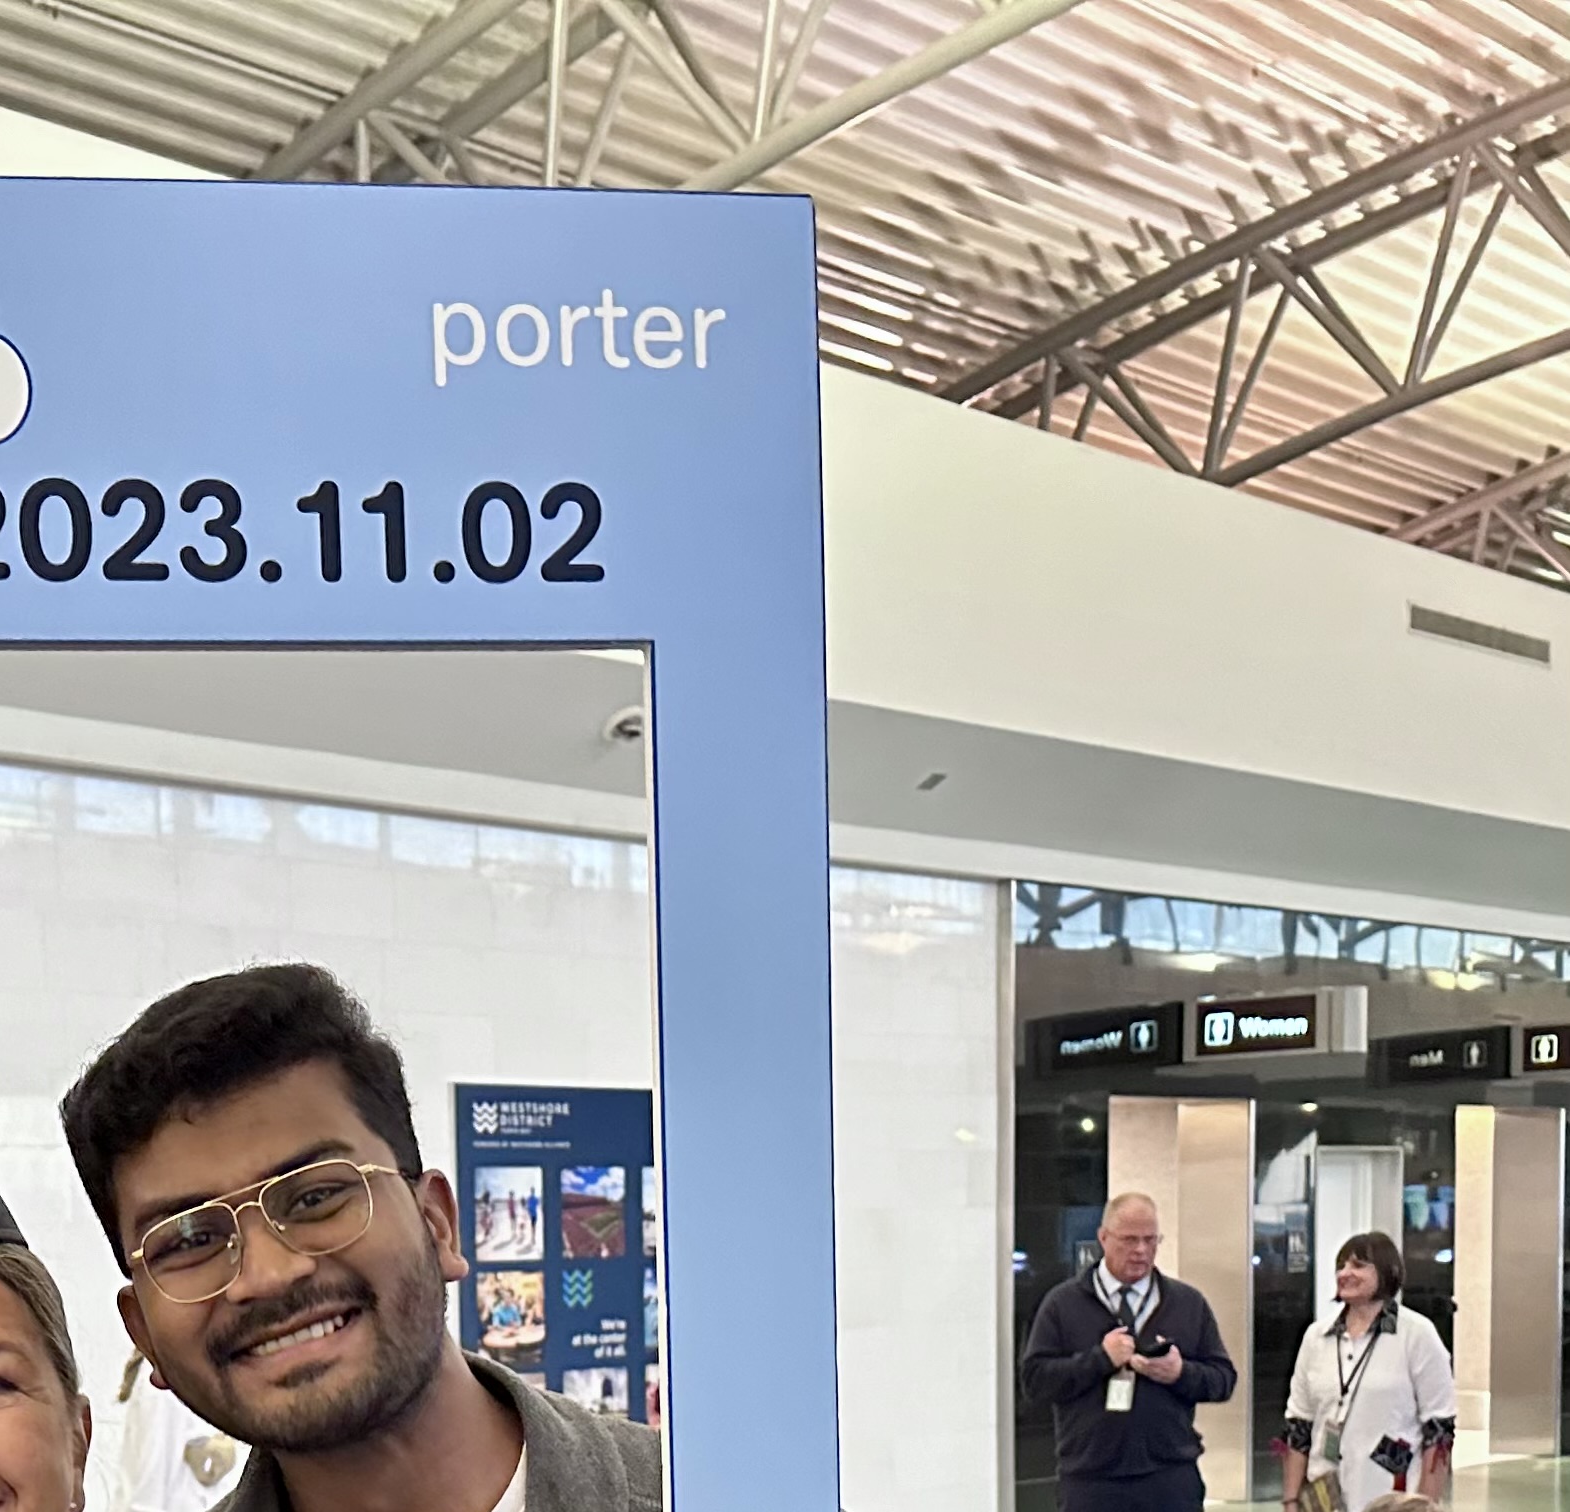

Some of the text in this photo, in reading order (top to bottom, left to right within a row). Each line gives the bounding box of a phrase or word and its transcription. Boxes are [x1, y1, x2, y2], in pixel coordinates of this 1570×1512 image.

[432, 288, 727, 388] porter
[1238, 1015, 1309, 1039] Women
[500, 1101, 570, 1115] WESTSHORE
[500, 1114, 553, 1127] DISTRICT
